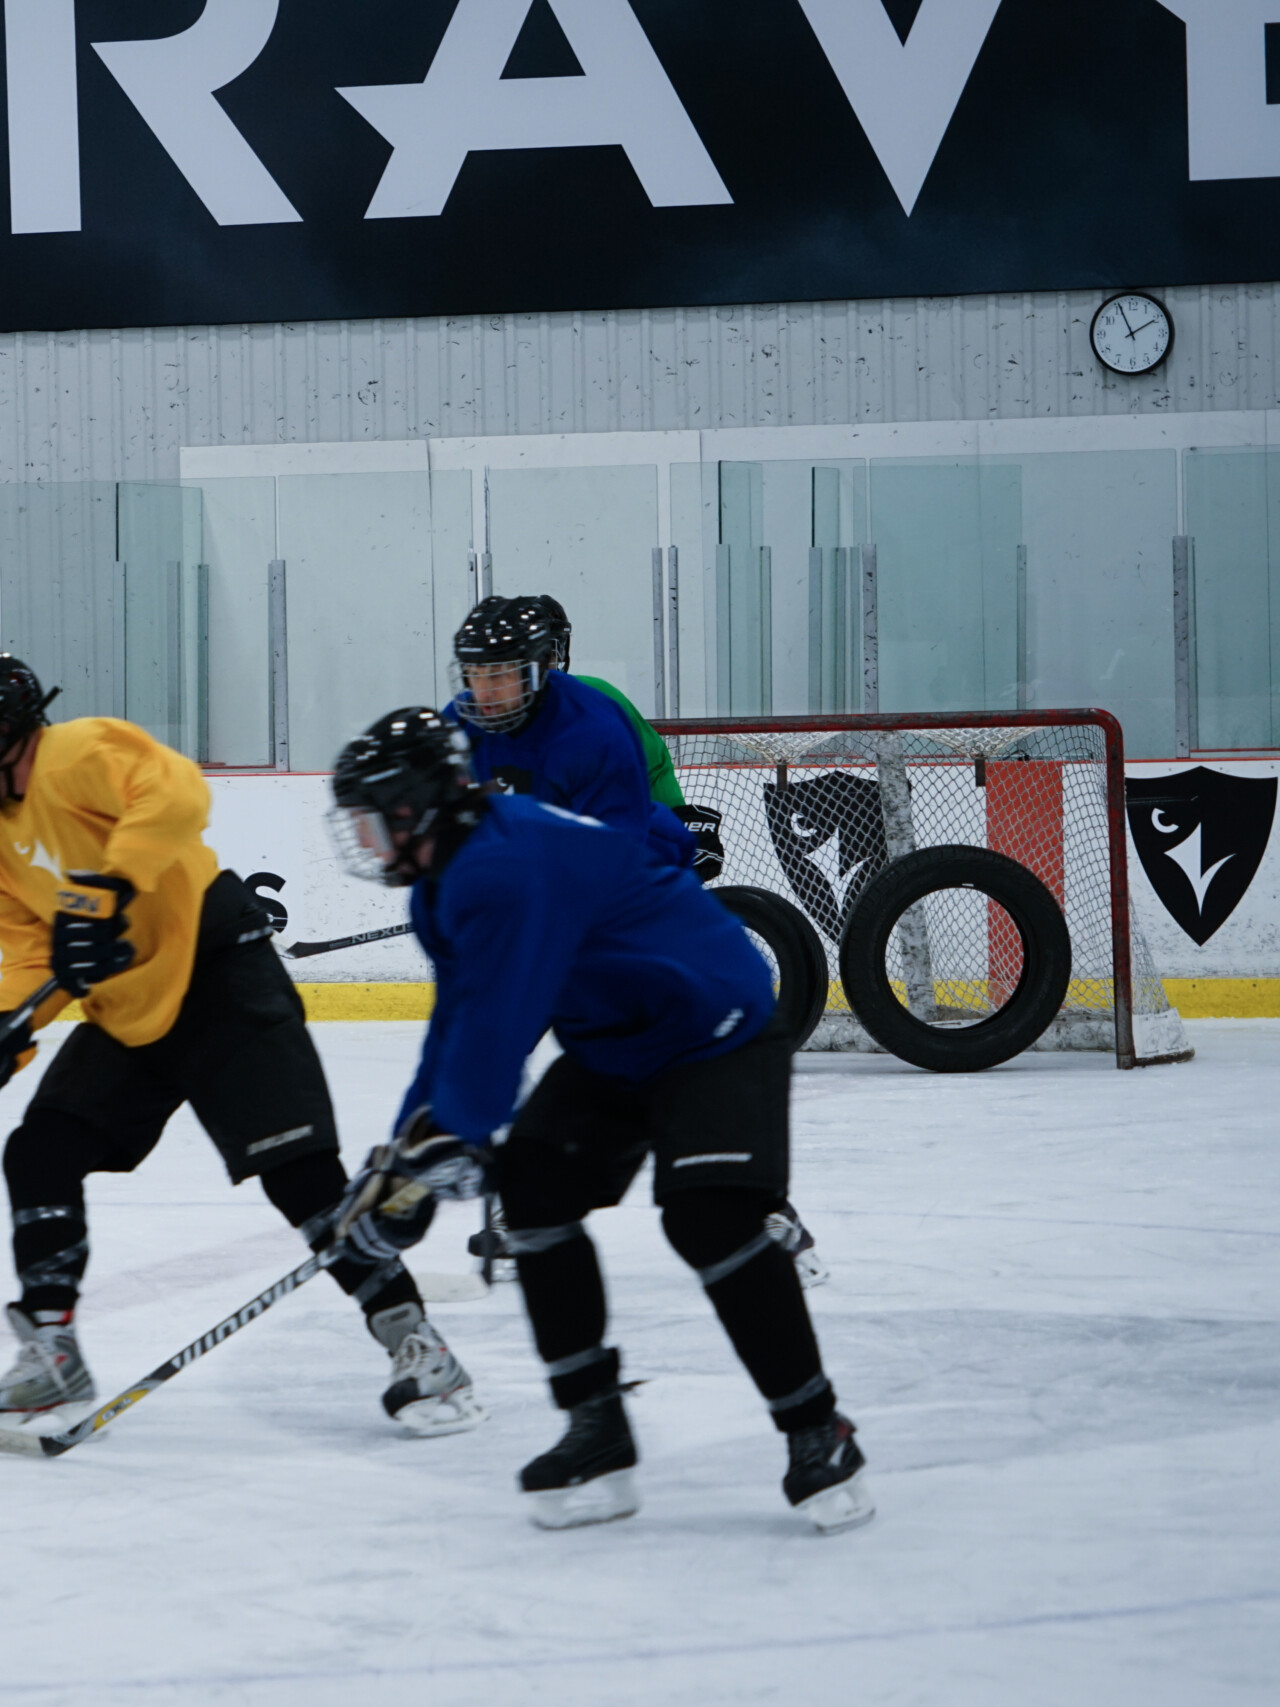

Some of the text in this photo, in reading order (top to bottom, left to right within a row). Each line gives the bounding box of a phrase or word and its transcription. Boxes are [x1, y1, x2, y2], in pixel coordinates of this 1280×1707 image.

[1128, 301, 1138, 311] 12
[1144, 304, 1148, 314] 1
[1105, 316, 1115, 325] 10
[1152, 314, 1160, 323] 2
[1099, 330, 1106, 338] 9
[1158, 329, 1165, 338] 3
[1105, 344, 1111, 353] 8
[1153, 342, 1159, 352] 4
[1115, 354, 1122, 364] 7
[1129, 357, 1136, 366] 6
[1143, 353, 1150, 362] 5
